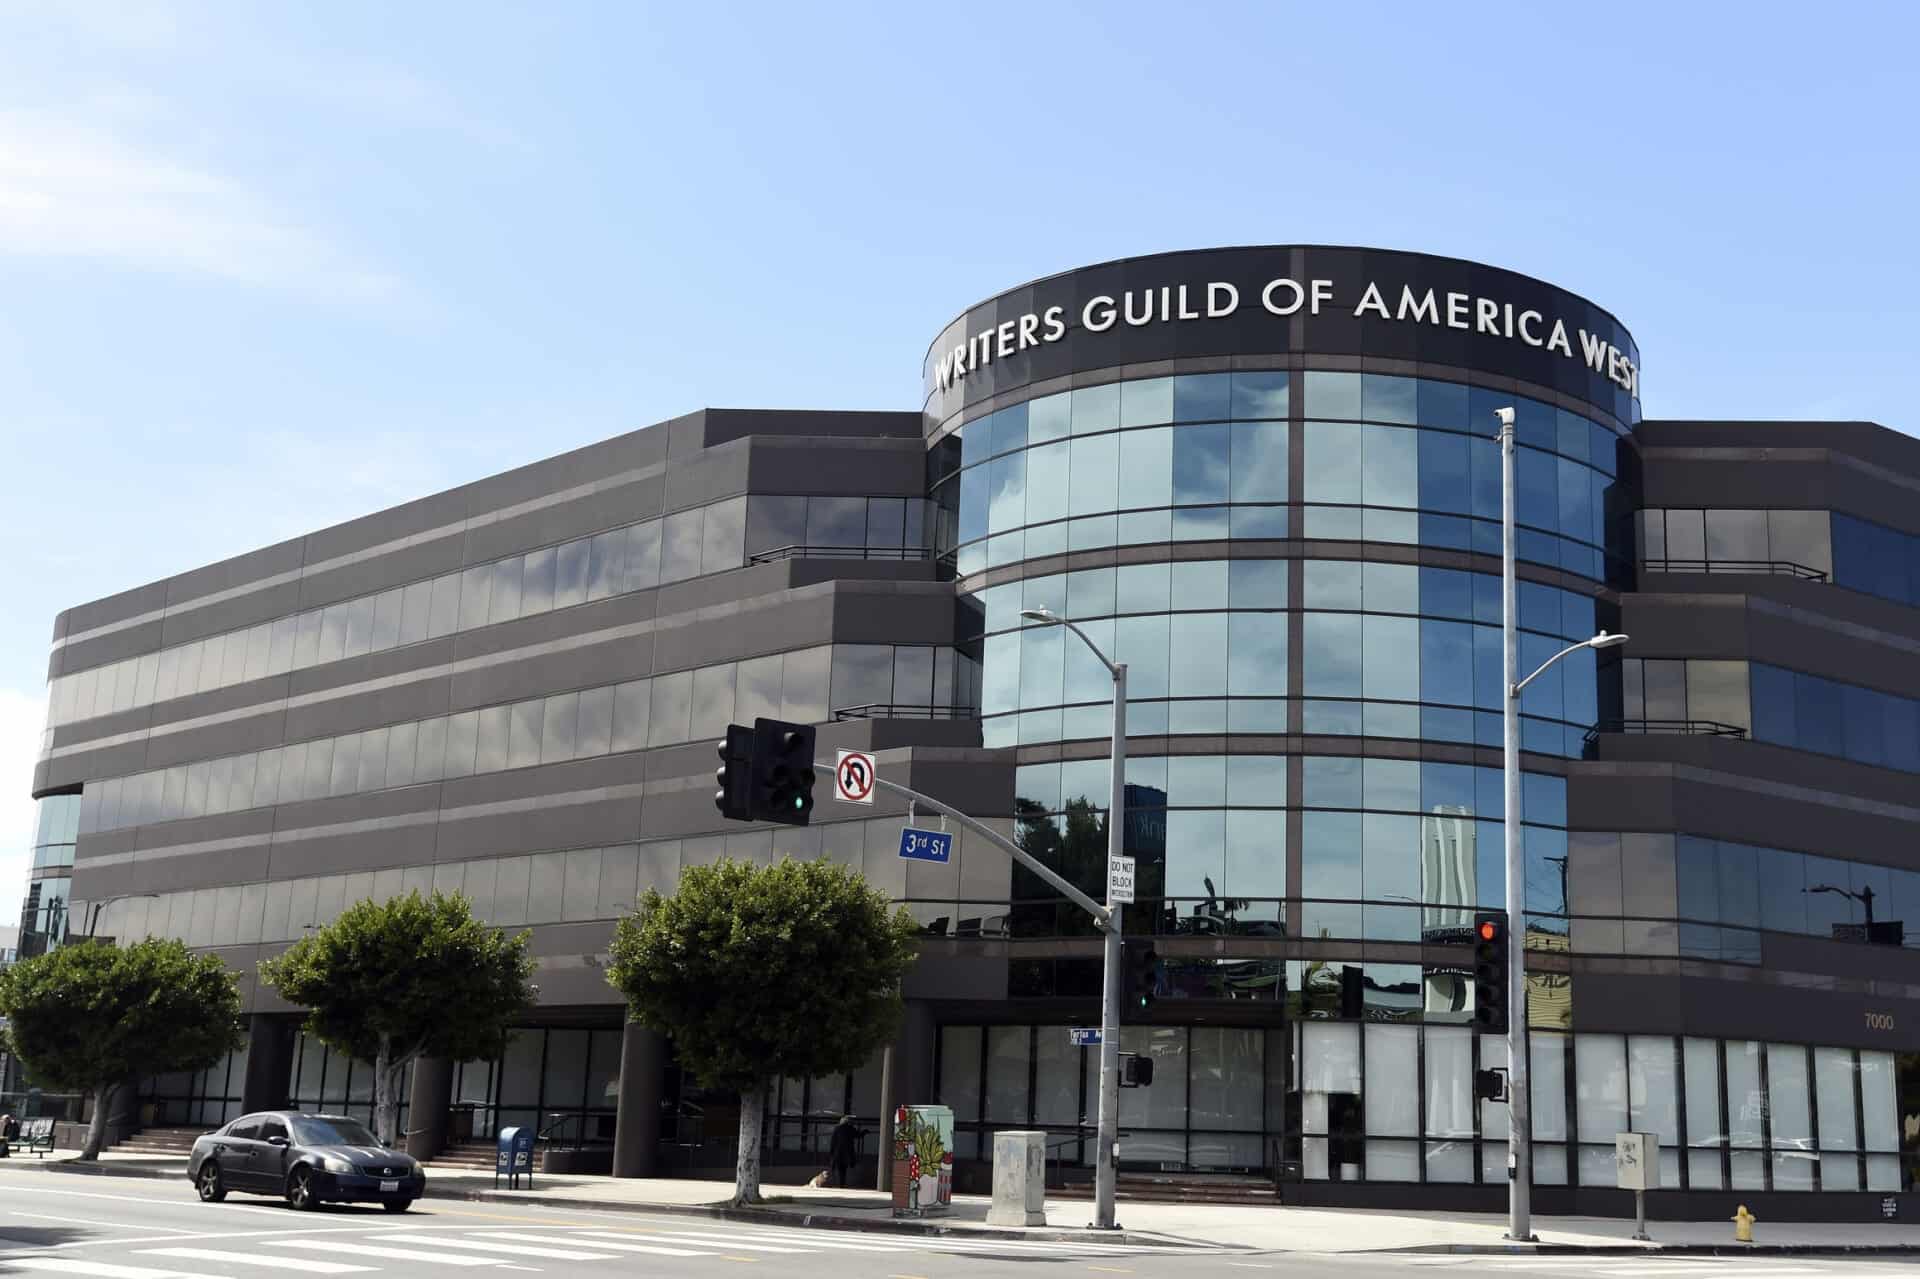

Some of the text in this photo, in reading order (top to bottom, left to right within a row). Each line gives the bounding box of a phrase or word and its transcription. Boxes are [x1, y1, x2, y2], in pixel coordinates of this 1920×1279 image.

[935, 278, 1638, 398] WRITERS GUILD OF AMERICA WEST
[906, 834, 945, 856] 3rd St
[1122, 863, 1134, 873] NOT
[1112, 875, 1132, 888] BLOCK
[1864, 1012, 1894, 1030] 7000
